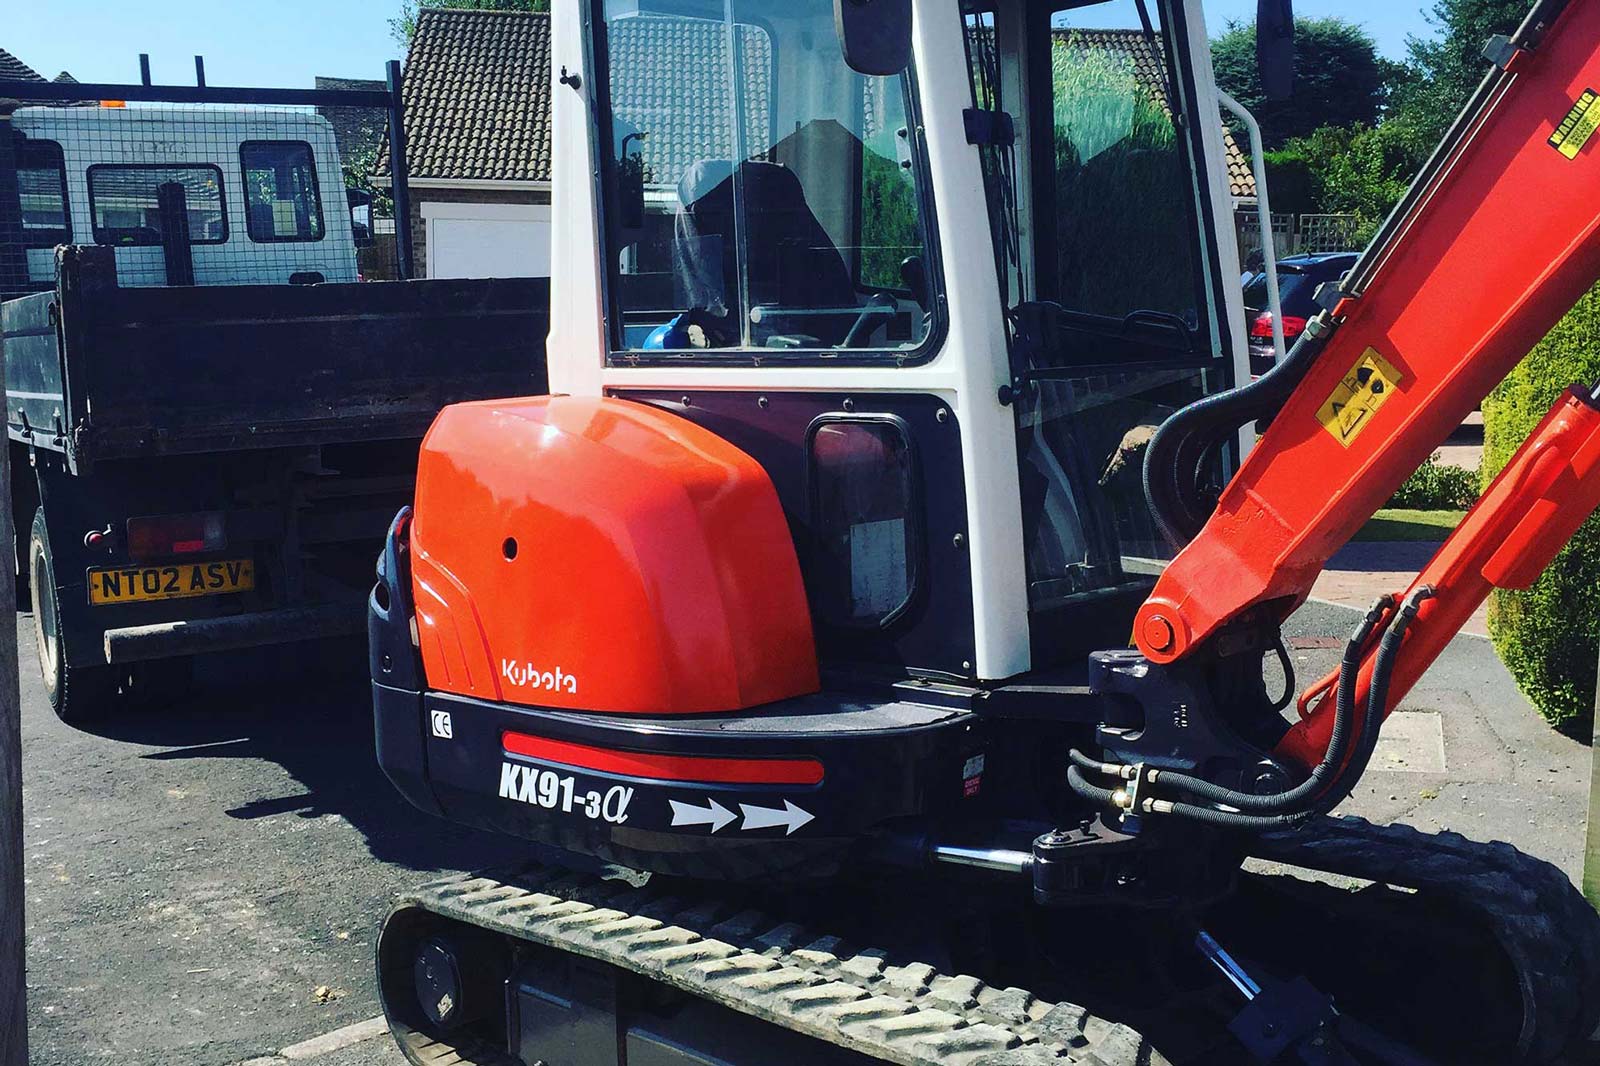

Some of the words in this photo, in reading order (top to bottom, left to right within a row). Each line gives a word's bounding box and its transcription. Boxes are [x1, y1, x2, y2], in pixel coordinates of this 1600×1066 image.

[1549, 91, 1594, 145] WARNING
[102, 568, 180, 598] NT02
[190, 562, 241, 591] ASV
[502, 658, 577, 694] Kubota
